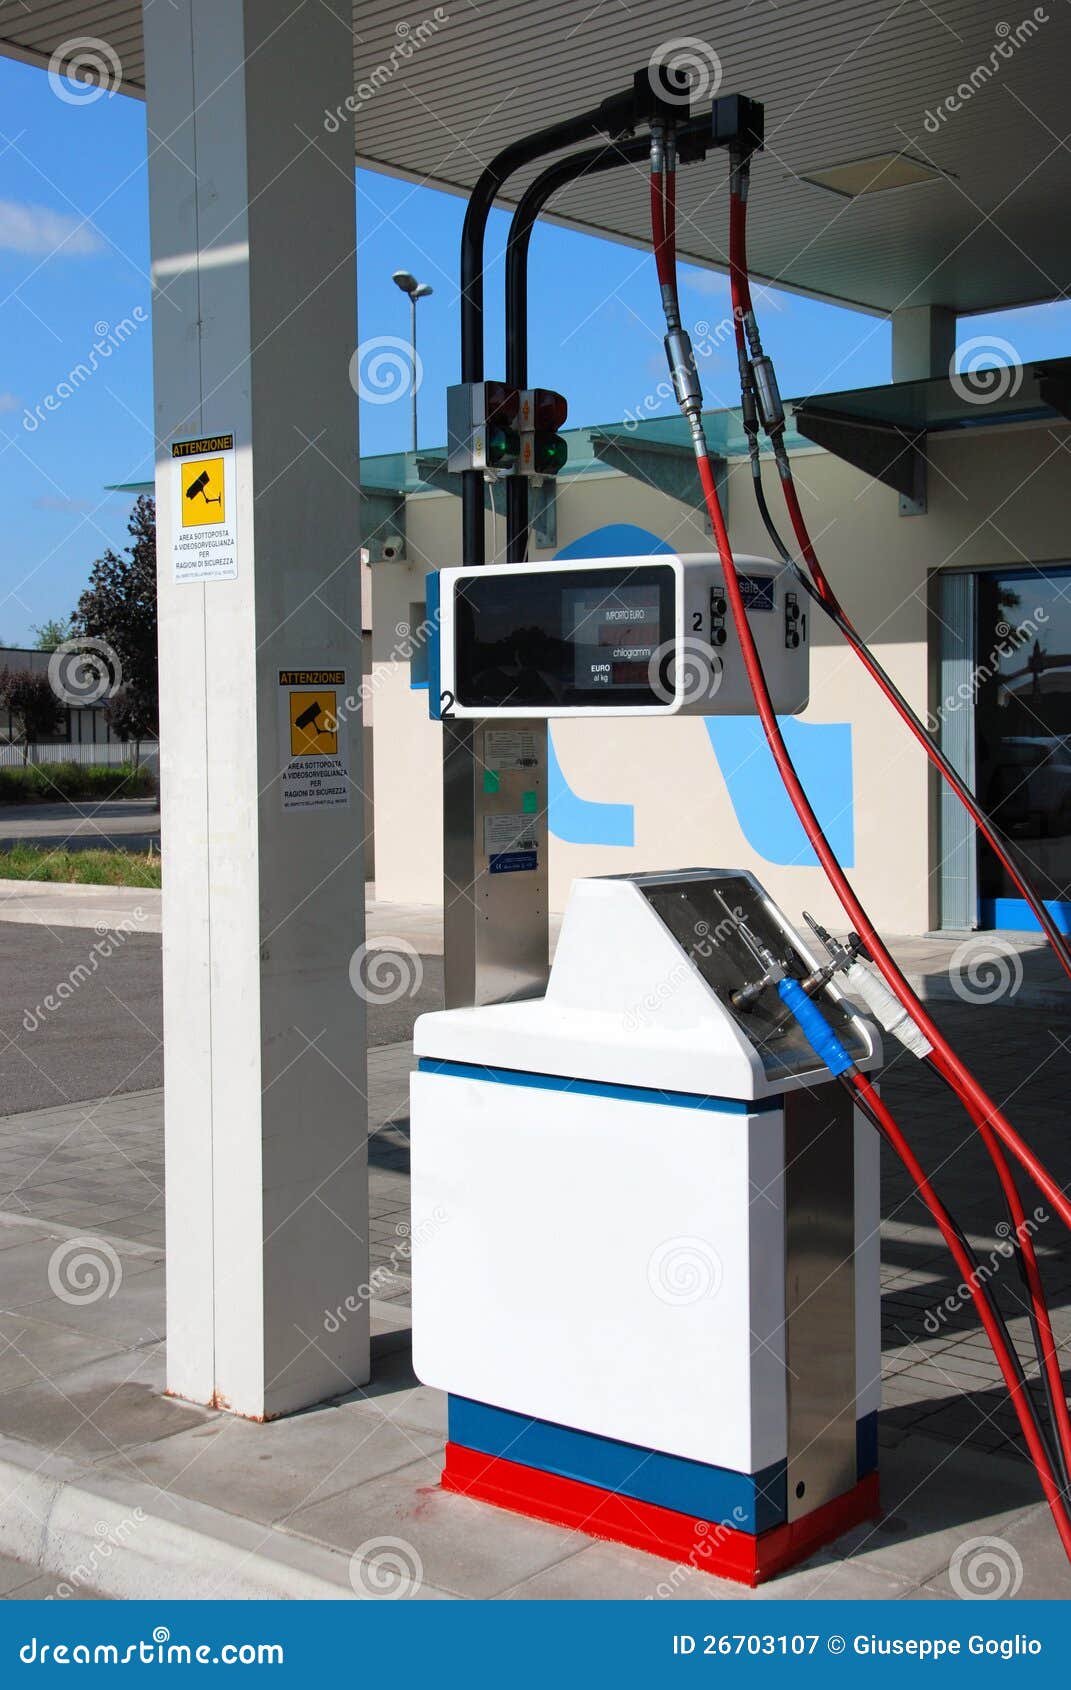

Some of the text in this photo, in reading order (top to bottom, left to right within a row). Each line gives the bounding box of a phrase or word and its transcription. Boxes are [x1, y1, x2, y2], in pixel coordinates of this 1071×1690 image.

[173, 436, 233, 457] ATTENZIONE!
[179, 530, 229, 541] AREA SOTTOPOSTA
[198, 550, 210, 558] PER
[204, 557, 234, 567] SICUREZZA
[606, 610, 629, 621] IMPORTO
[693, 612, 702, 632] 2
[801, 613, 806, 642] 1
[613, 648, 651, 659] chilogrammi
[591, 664, 611, 673] EURO
[281, 671, 344, 684] ATTENZIONE!
[440, 690, 455, 719] 2
[288, 762, 304, 770] AREA
[315, 787, 346, 796] SICUREZZA
